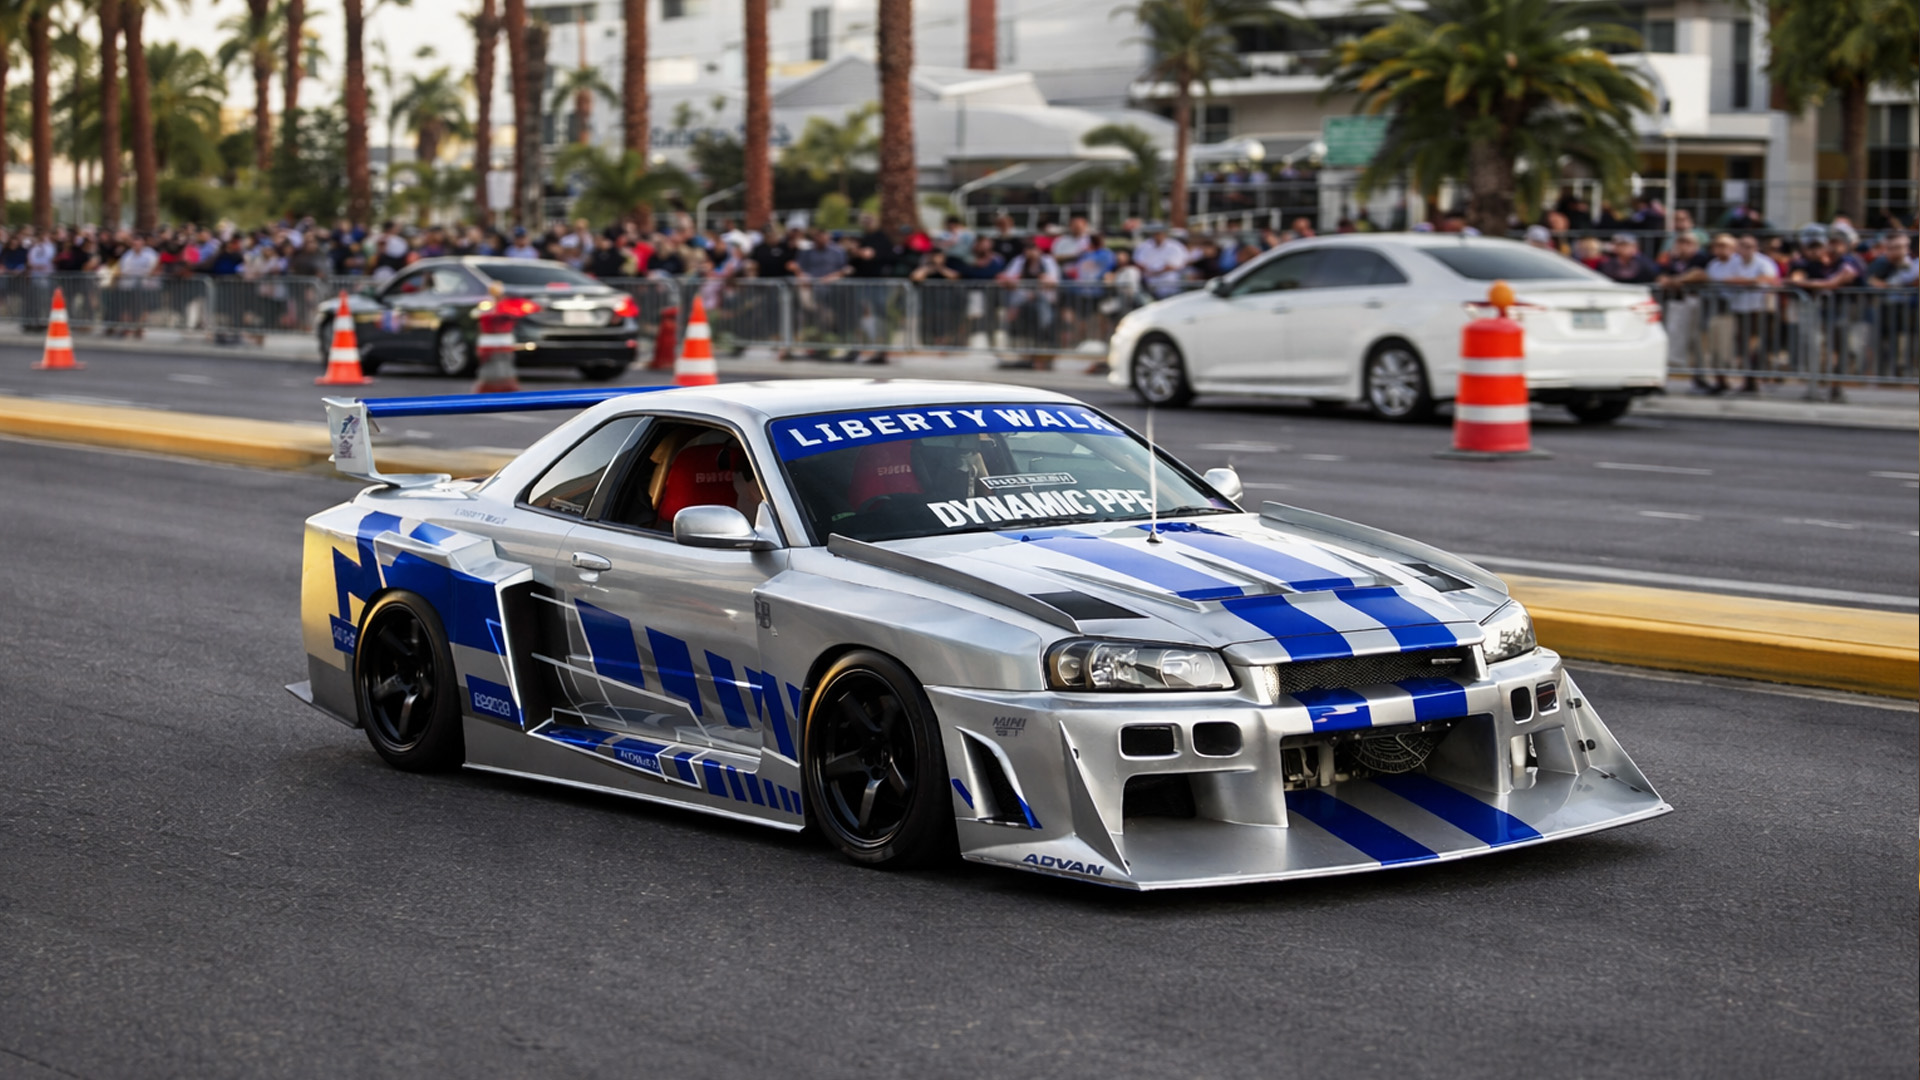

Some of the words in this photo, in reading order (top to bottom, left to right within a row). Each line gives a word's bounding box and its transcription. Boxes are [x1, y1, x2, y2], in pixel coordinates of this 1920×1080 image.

[788, 409, 987, 447] LIBERTY
[927, 491, 1096, 528] DYNAMIC
[1086, 489, 1153, 513] PPF
[1023, 854, 1104, 875] ADVAN
